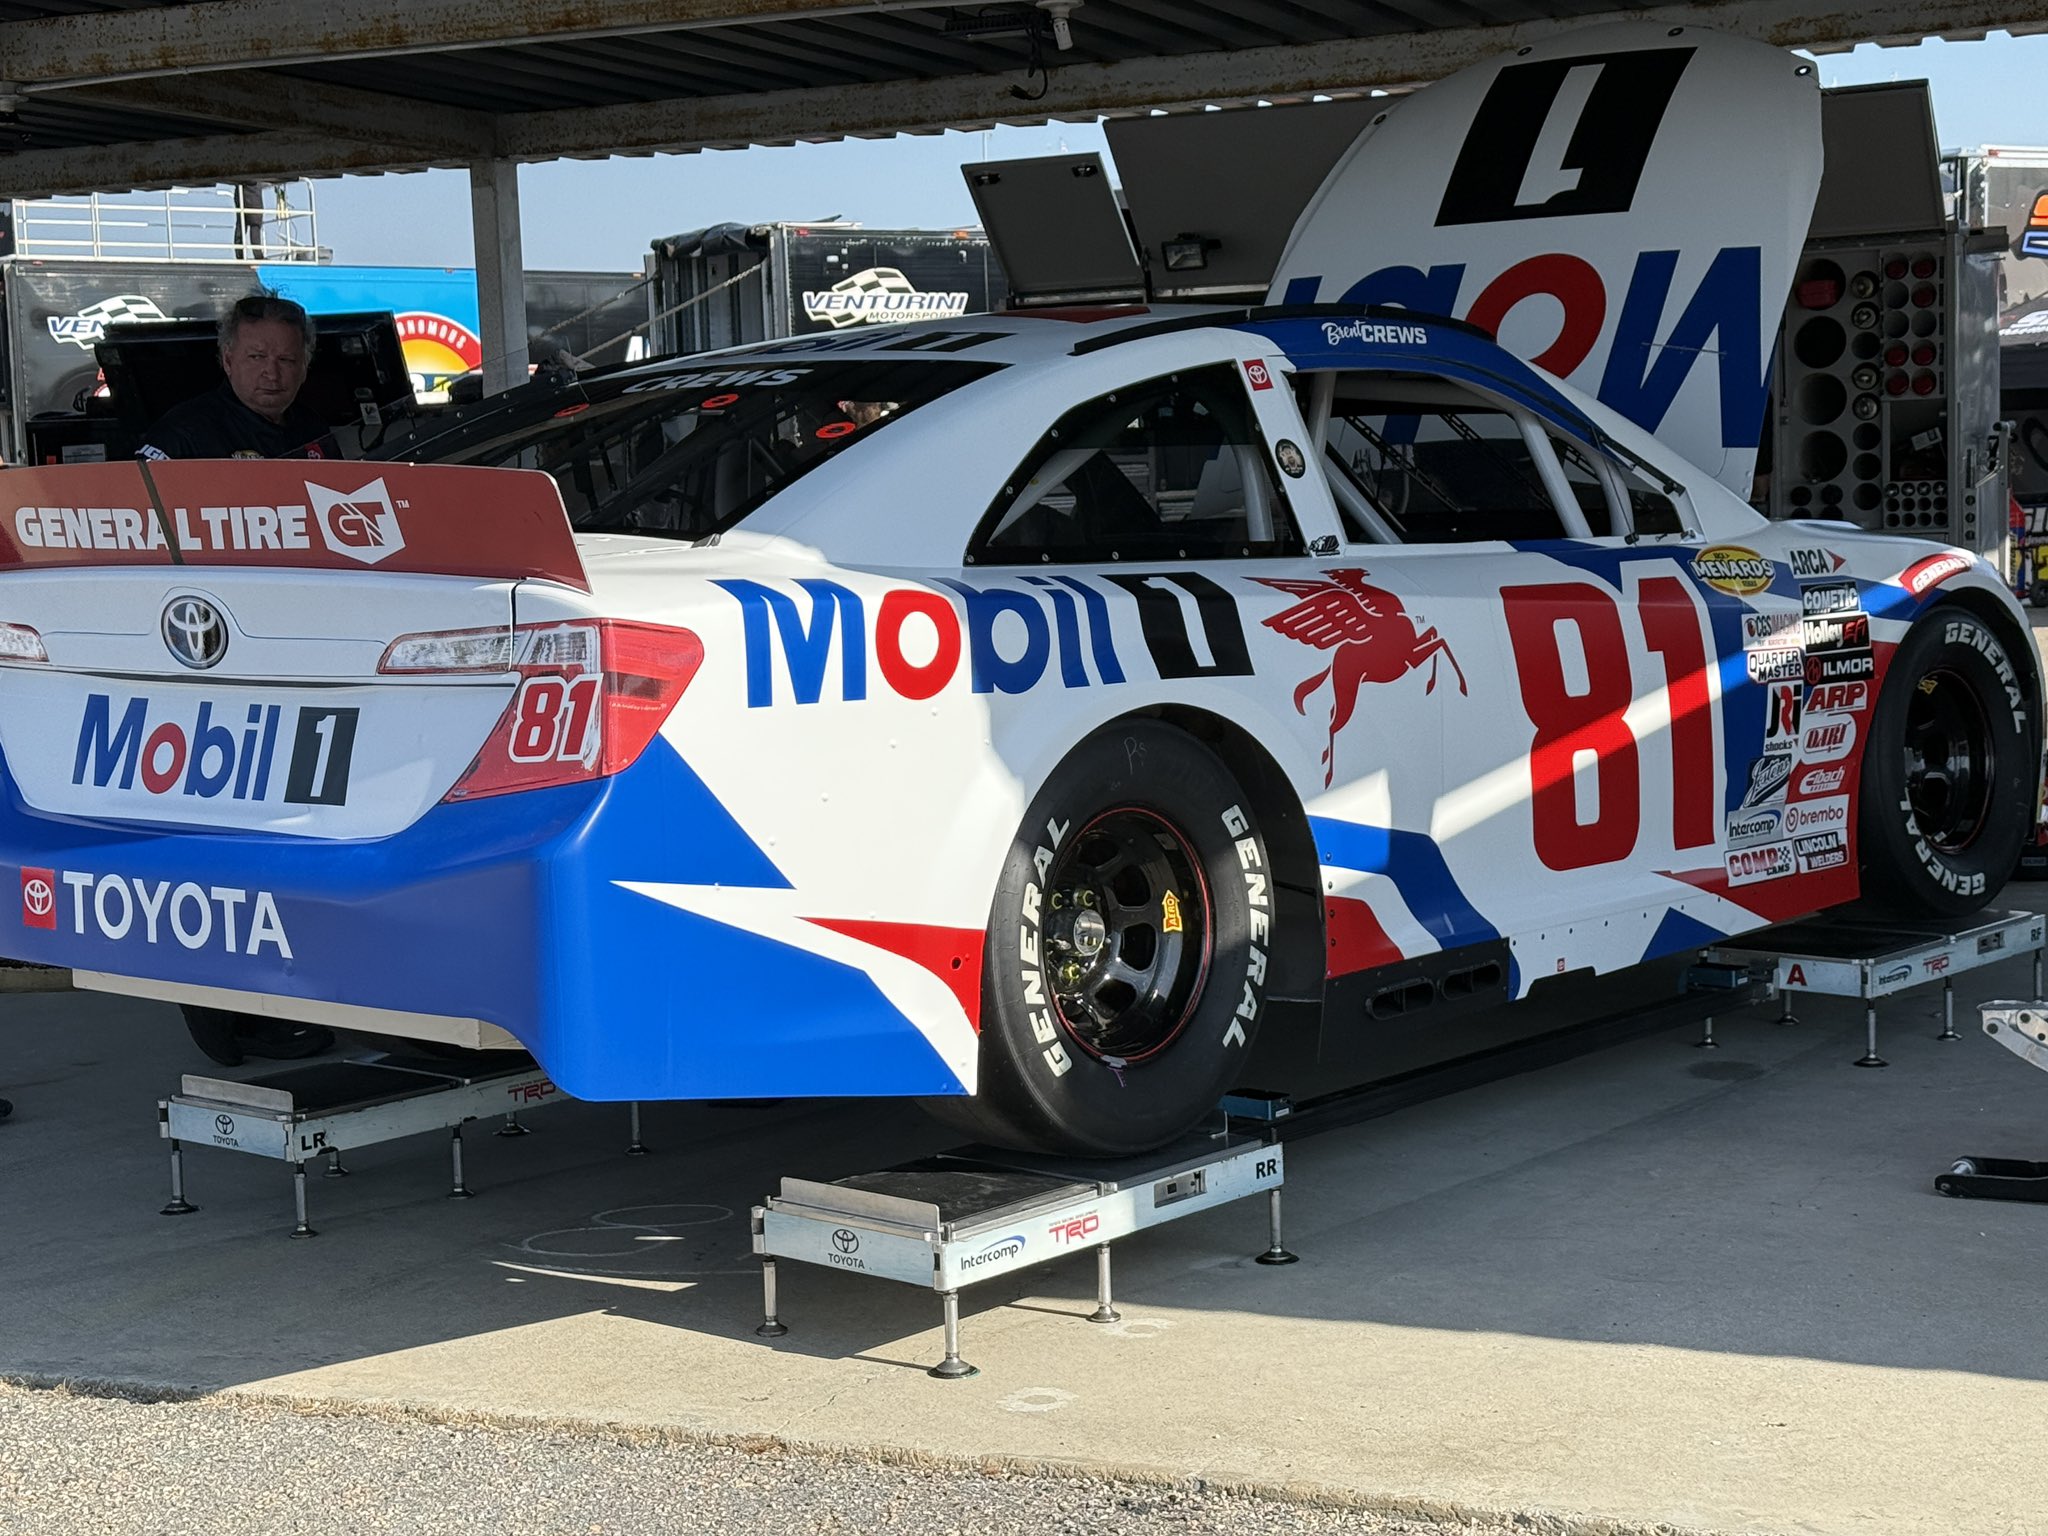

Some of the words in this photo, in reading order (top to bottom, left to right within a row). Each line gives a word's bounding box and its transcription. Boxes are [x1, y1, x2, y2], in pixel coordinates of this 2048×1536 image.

[803, 290, 967, 312] VENTURINI
[868, 310, 963, 322] MOTORSPORTS
[1321, 321, 1363, 346] Brent
[1361, 324, 1428, 345] CREWS
[621, 368, 815, 395] CREWS
[15, 507, 202, 552] GENERAL
[200, 505, 311, 550] TIRE
[1688, 559, 1775, 580] MENARDS
[1789, 549, 1830, 576] ARCA
[1803, 587, 1858, 610] COMETIC
[706, 577, 1128, 709] Mobil
[1804, 619, 1844, 648] Holley
[1749, 650, 1800, 674] QUARTER
[1758, 664, 1802, 681] MASTER
[1823, 657, 1874, 677] ILMOR
[1944, 621, 2027, 735] GENERAL
[1805, 683, 1867, 711] ARP
[509, 673, 603, 763] 81
[1500, 576, 1717, 873] 81
[72, 693, 282, 803] Mobil
[1765, 739, 1793, 752] shocks
[1800, 805, 1844, 826] brembo
[1729, 818, 1776, 839] Intercomp
[1798, 833, 1839, 853] LINCOLN
[1900, 786, 1986, 896] GENERAL
[1728, 847, 1779, 878] COMP
[1766, 862, 1791, 877] CAMS
[1809, 850, 1845, 868] WELDERS
[62, 870, 294, 960] TOYOTA
[1166, 897, 1181, 928] AERO
[1221, 803, 1271, 1049] GENERAL
[2030, 926, 2042, 943] RF
[1020, 816, 1071, 1078] GENERAL
[1786, 963, 1808, 987] A
[1922, 955, 1950, 976] TRD
[507, 1081, 557, 1104] TRD
[212, 1134, 240, 1148] TOYOTA
[301, 1131, 327, 1152] LR
[1255, 1158, 1278, 1180] RR
[1048, 1214, 1100, 1245] TRD
[827, 1251, 866, 1270] TOYOTA
[960, 1240, 1020, 1271] Intercomp
